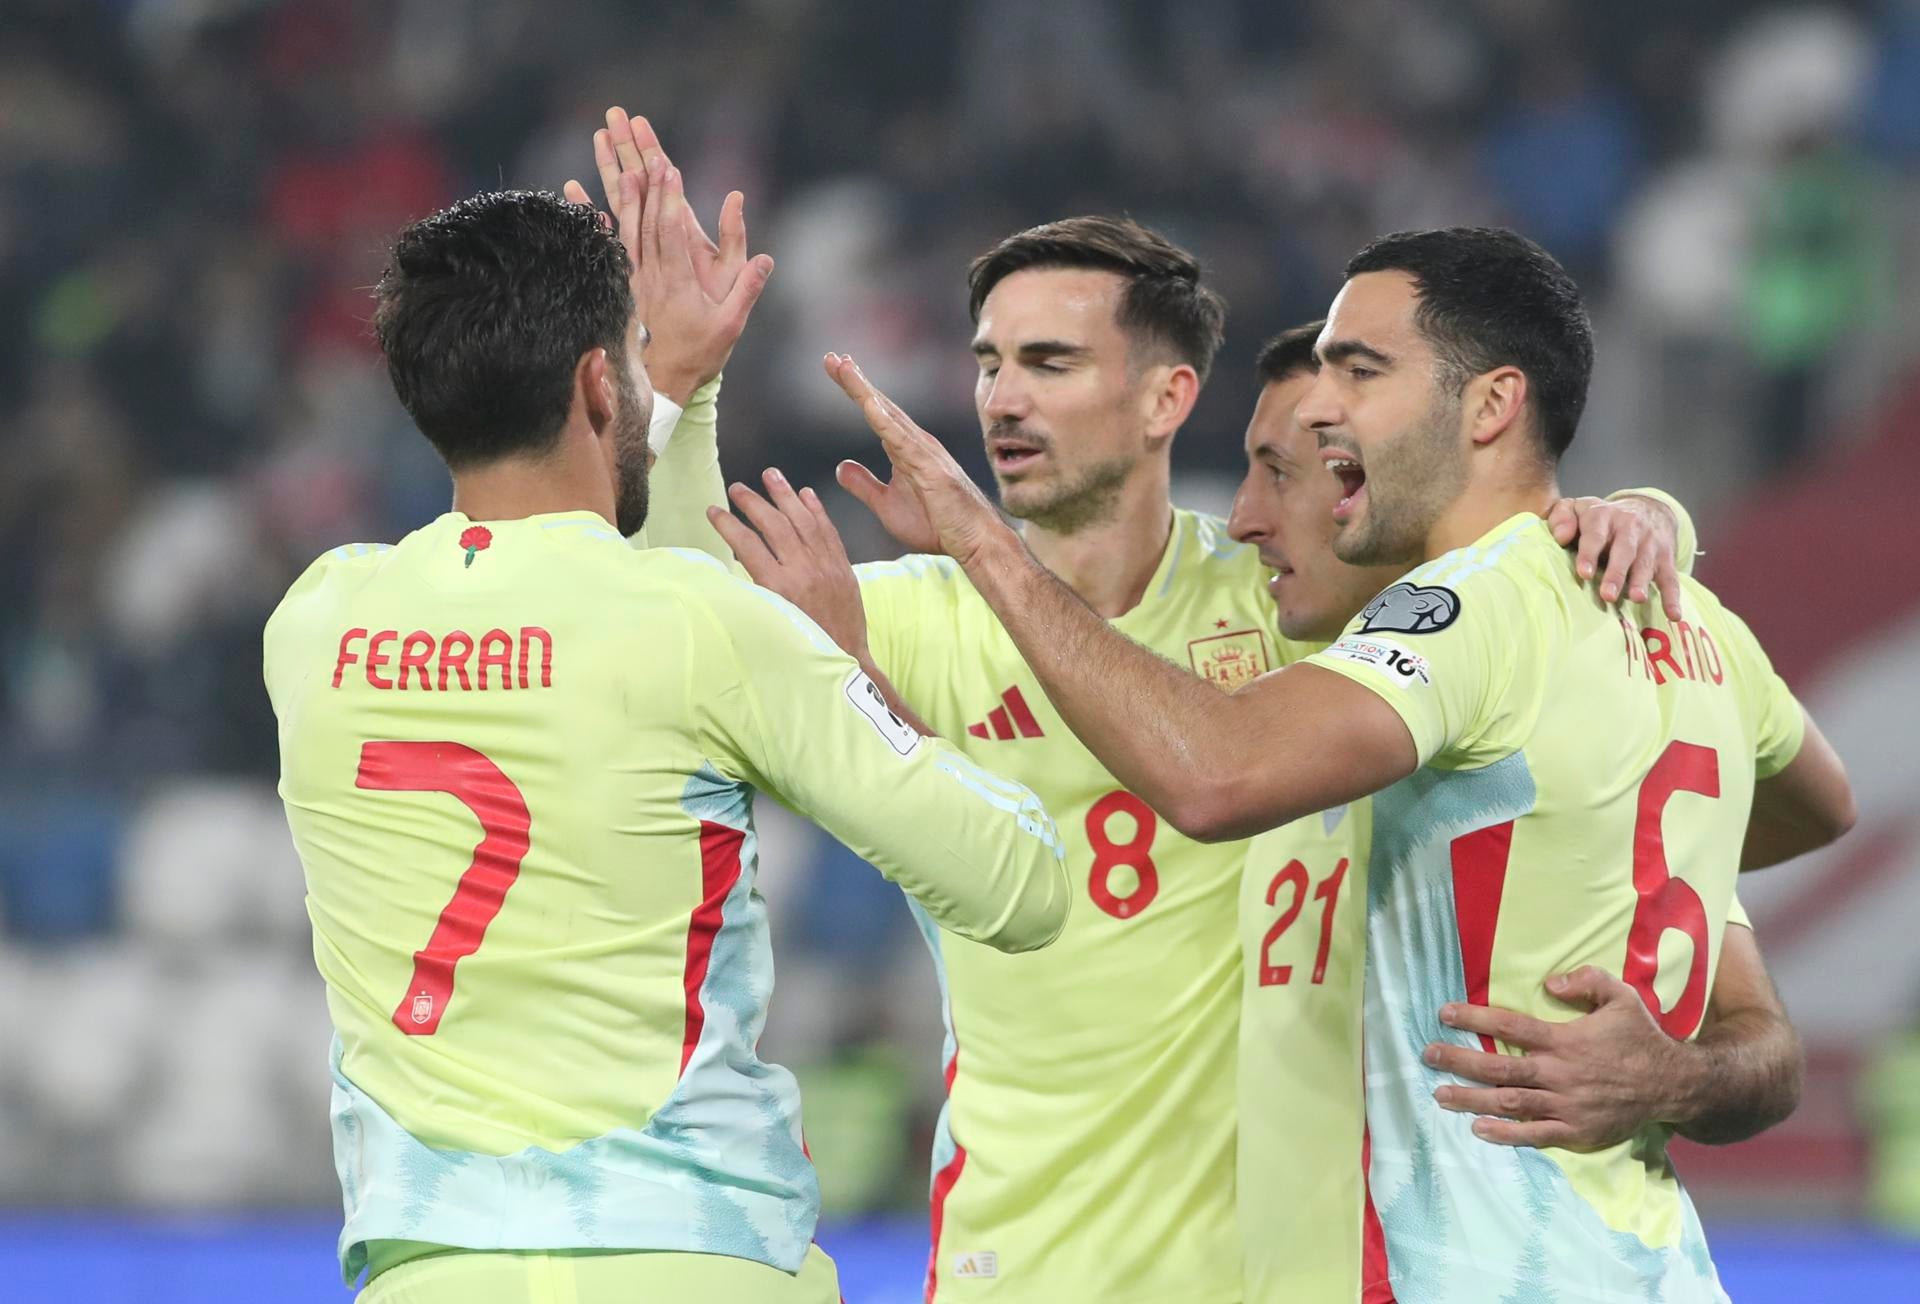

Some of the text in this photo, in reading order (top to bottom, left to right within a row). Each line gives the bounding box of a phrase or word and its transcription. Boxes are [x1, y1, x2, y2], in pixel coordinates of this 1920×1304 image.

[332, 627, 552, 692] FERRAN
[355, 740, 532, 1036] 7
[1084, 790, 1159, 920] 8
[1622, 740, 1721, 1042] 6
[1259, 857, 1350, 987] 21
